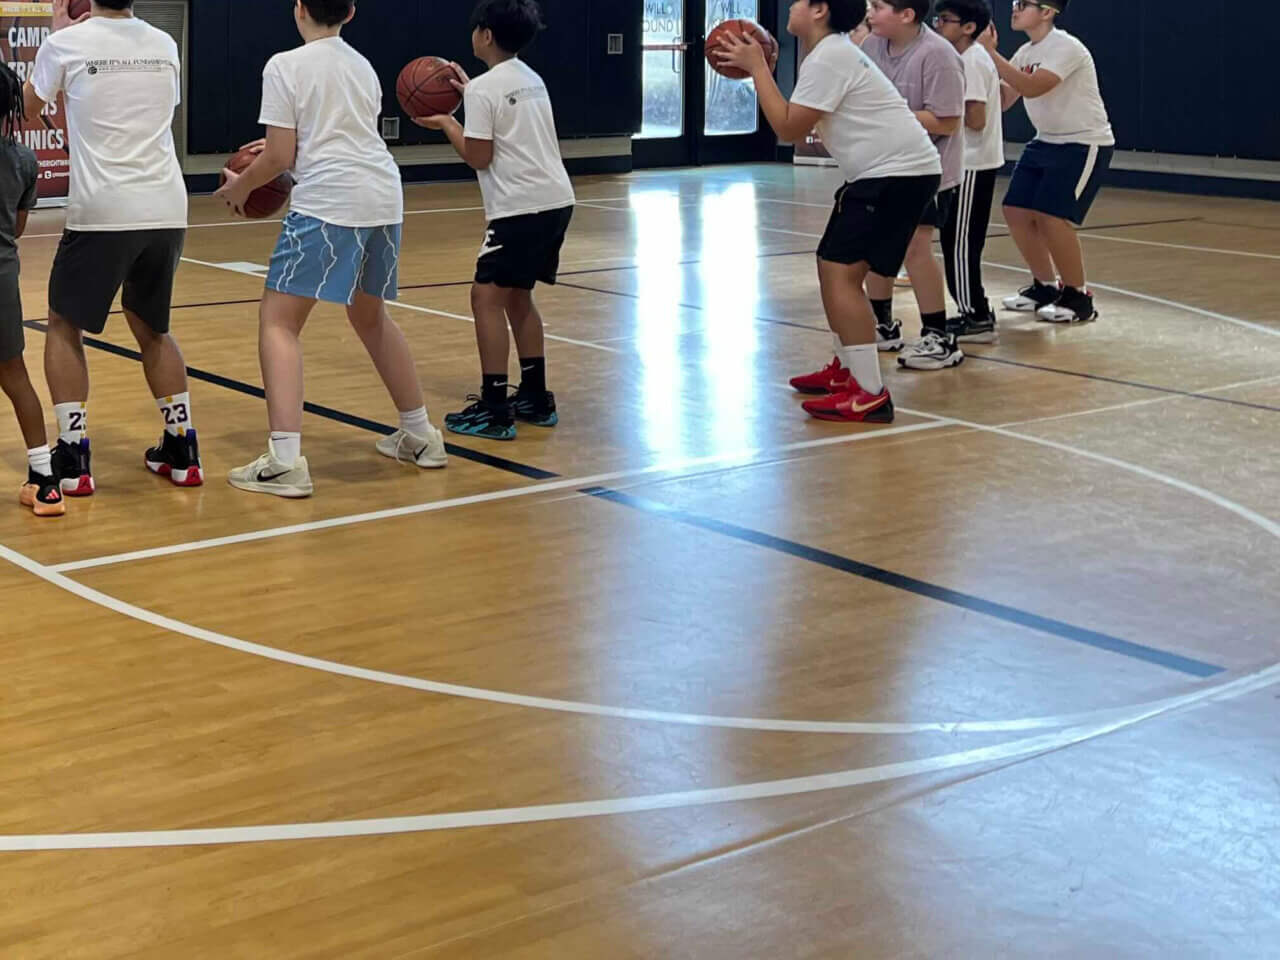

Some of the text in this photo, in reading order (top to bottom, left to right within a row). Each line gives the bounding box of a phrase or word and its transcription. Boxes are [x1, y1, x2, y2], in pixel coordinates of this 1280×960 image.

[8, 26, 50, 48] CAMP
[643, 20, 674, 32] OUND
[160, 403, 188, 425] 23
